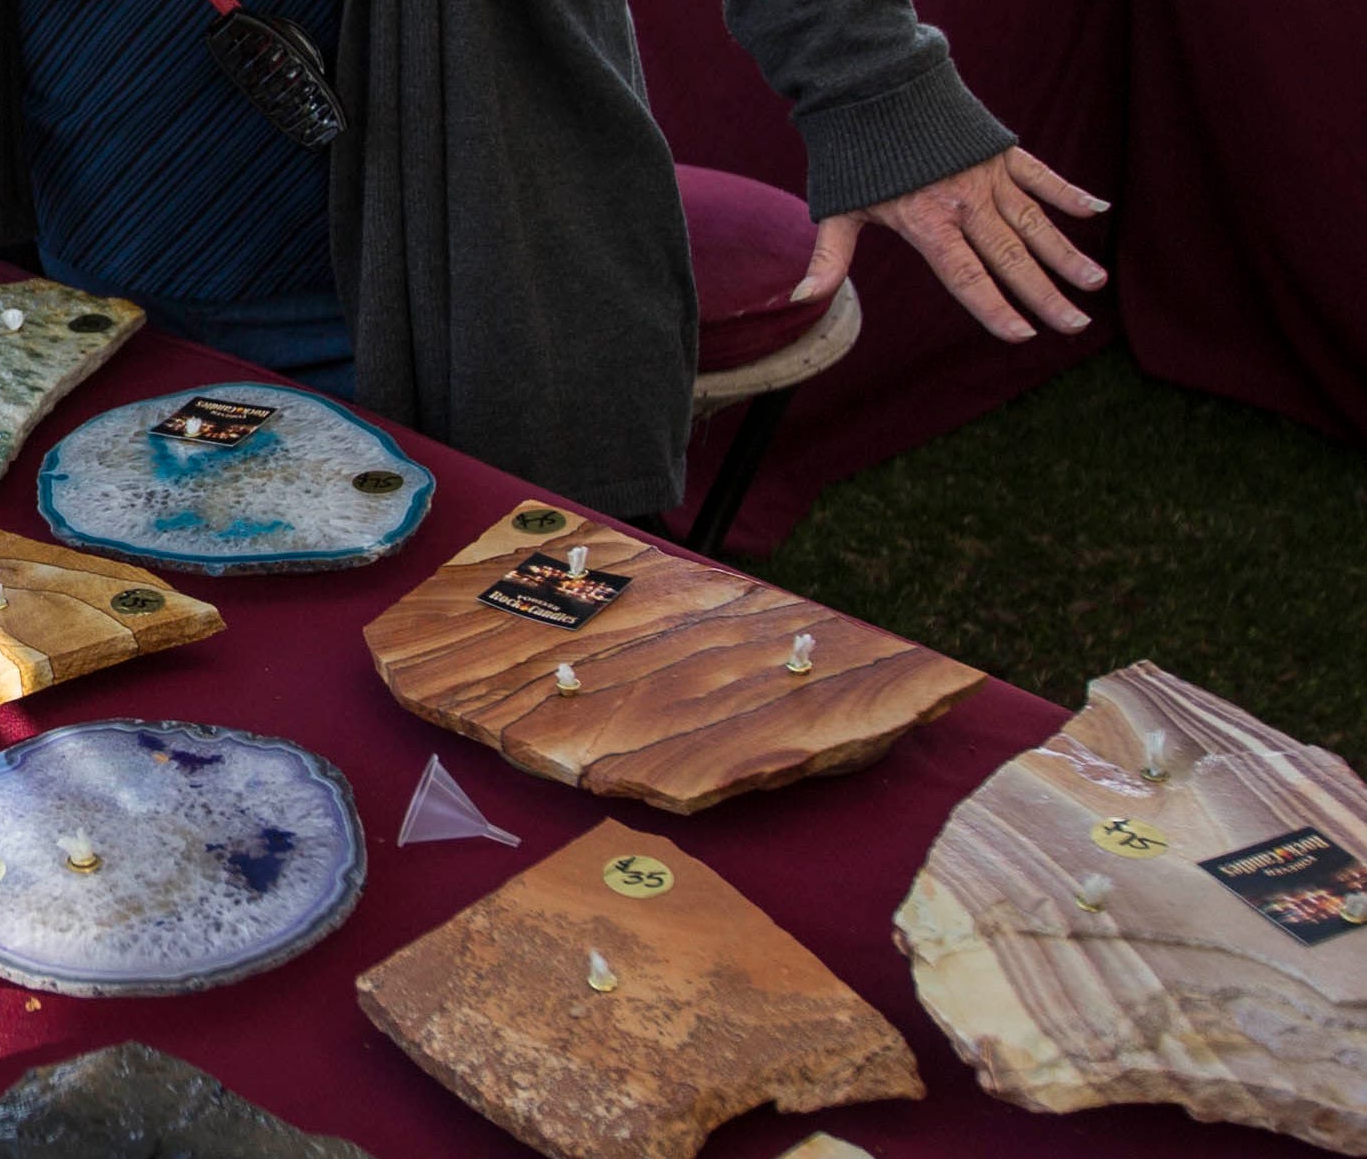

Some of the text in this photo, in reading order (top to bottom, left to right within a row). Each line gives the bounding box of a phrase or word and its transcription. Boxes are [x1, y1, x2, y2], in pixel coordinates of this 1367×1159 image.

[489, 591, 578, 625] Rock Candies
[516, 594, 562, 611] FOREVER
[615, 856, 667, 888] $35
[1218, 834, 1330, 877] Rock Candies
